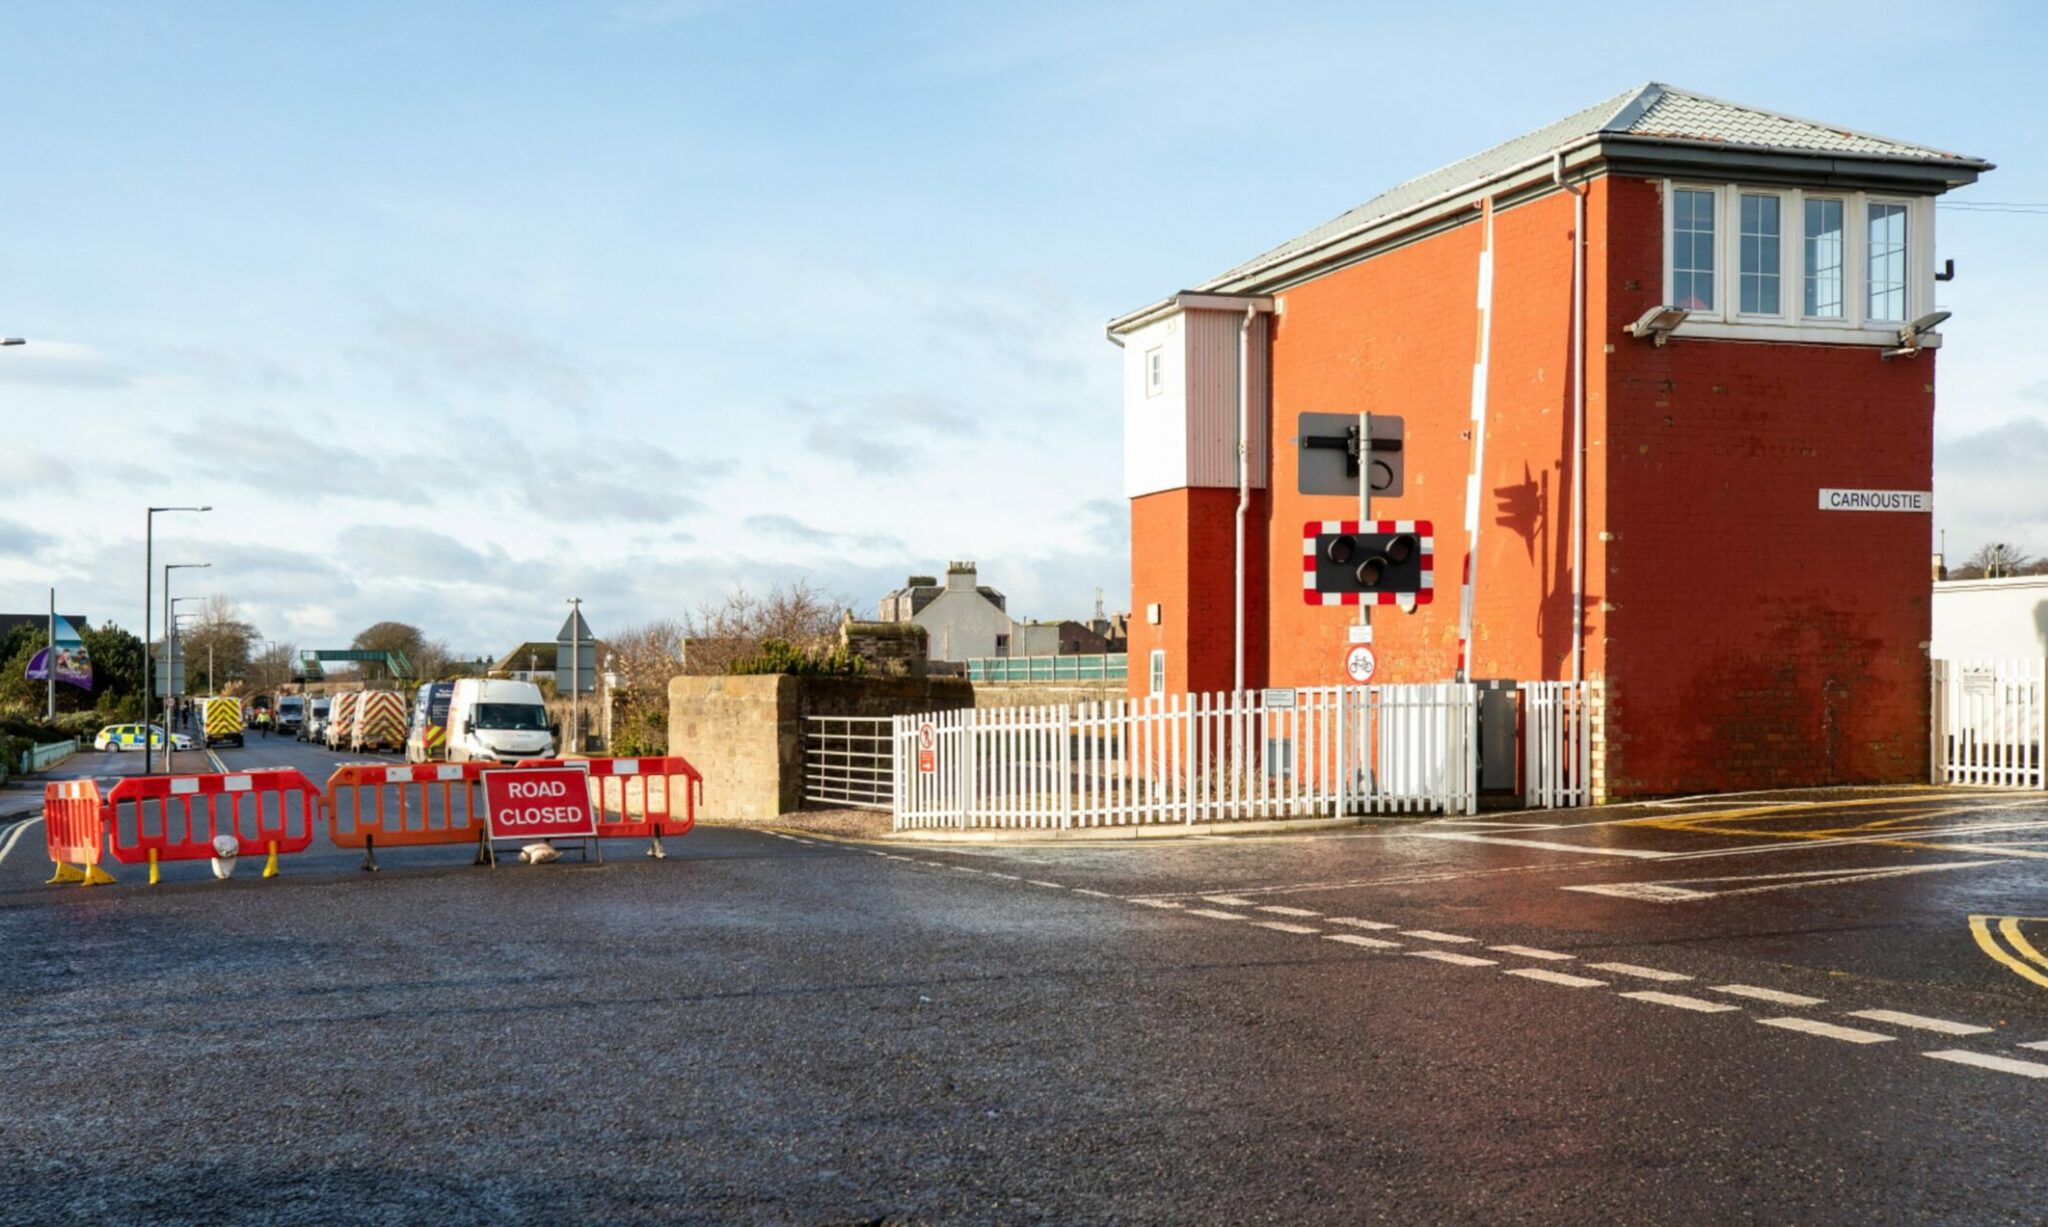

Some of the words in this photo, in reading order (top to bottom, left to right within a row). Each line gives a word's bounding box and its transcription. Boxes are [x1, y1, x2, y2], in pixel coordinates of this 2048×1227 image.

[1831, 492, 1922, 508] CARNOUSTIE
[508, 781, 566, 798] ROAD
[499, 806, 582, 825] CLOSED
